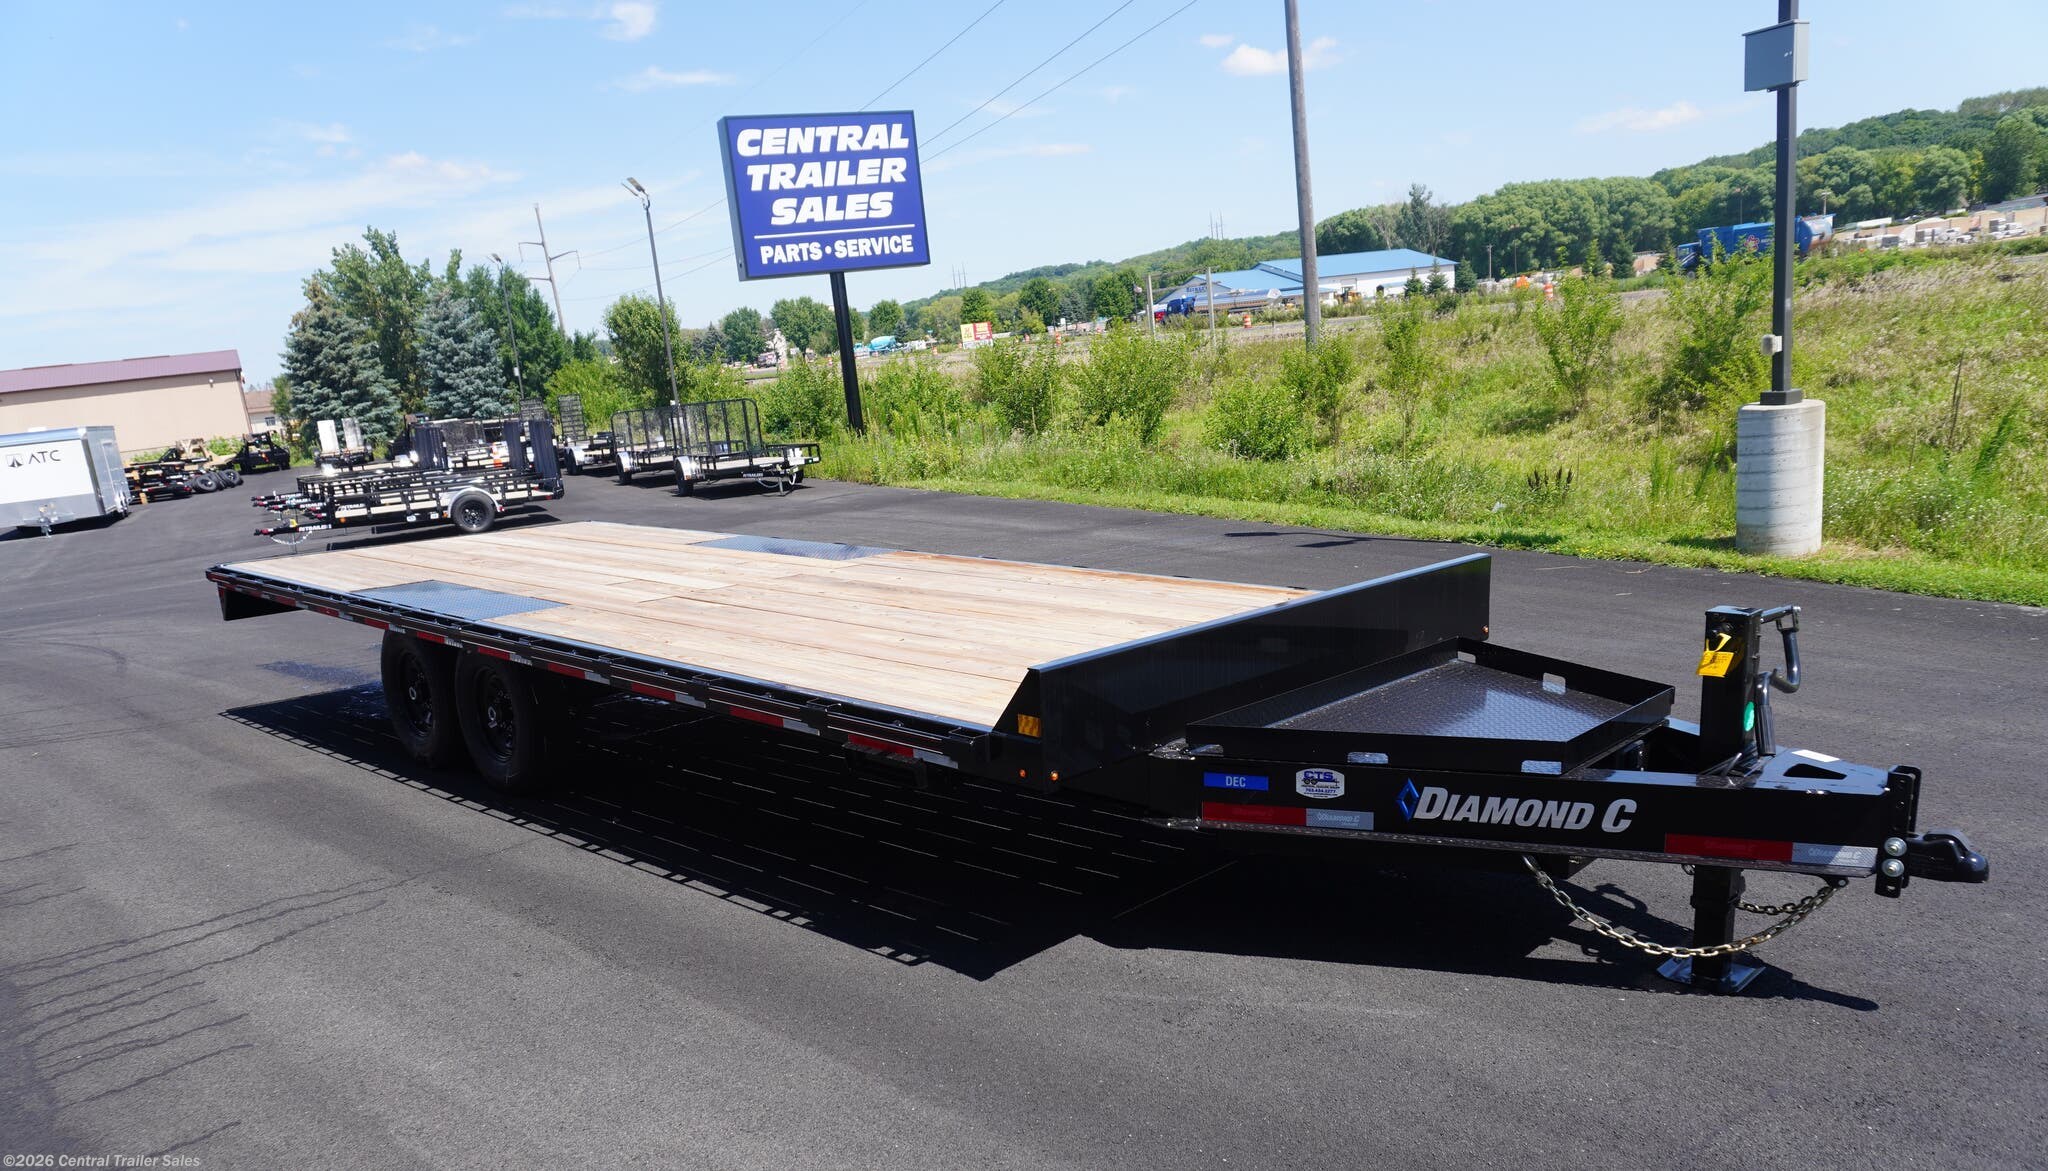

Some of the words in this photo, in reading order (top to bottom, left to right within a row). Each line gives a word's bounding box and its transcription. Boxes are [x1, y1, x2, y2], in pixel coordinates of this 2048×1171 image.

[737, 123, 909, 157] CENTRAL
[747, 157, 907, 192] TRAILER
[771, 191, 894, 226] SALES
[760, 241, 823, 265] PARTS
[834, 234, 914, 259] SERVICE
[28, 449, 62, 465] ATC
[1225, 775, 1246, 788] DEC
[1304, 770, 1334, 781] CTS
[1413, 786, 1595, 830] DIAMOND
[1601, 798, 1638, 833] C
